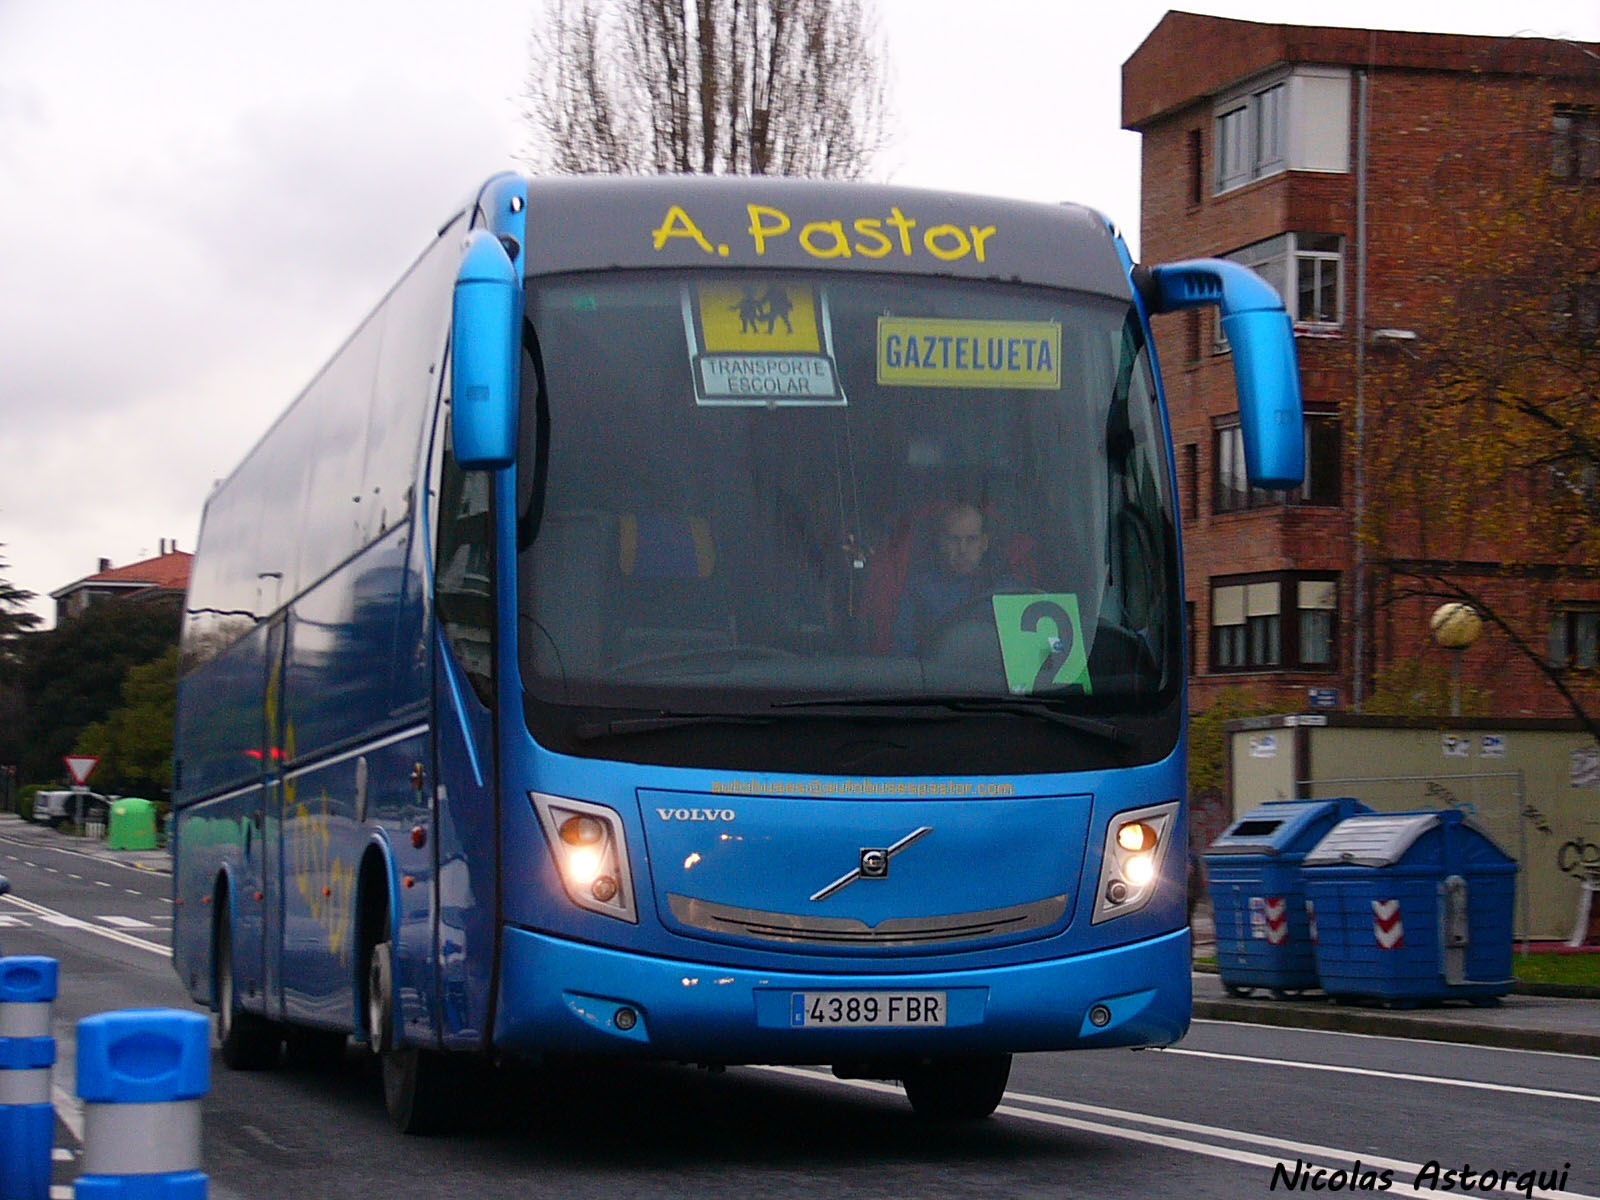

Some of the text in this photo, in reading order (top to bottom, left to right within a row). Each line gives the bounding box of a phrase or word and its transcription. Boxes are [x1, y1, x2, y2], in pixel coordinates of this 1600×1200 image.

[652, 203, 996, 263] A. Pastor
[885, 333, 1053, 372] GAZTELUETA
[709, 358, 826, 377] TRANSPORTE
[727, 376, 811, 393] ESCOLAR
[1020, 600, 1083, 695] 2
[656, 808, 735, 821] VOLVO
[810, 996, 939, 1023] 4389 FBR
